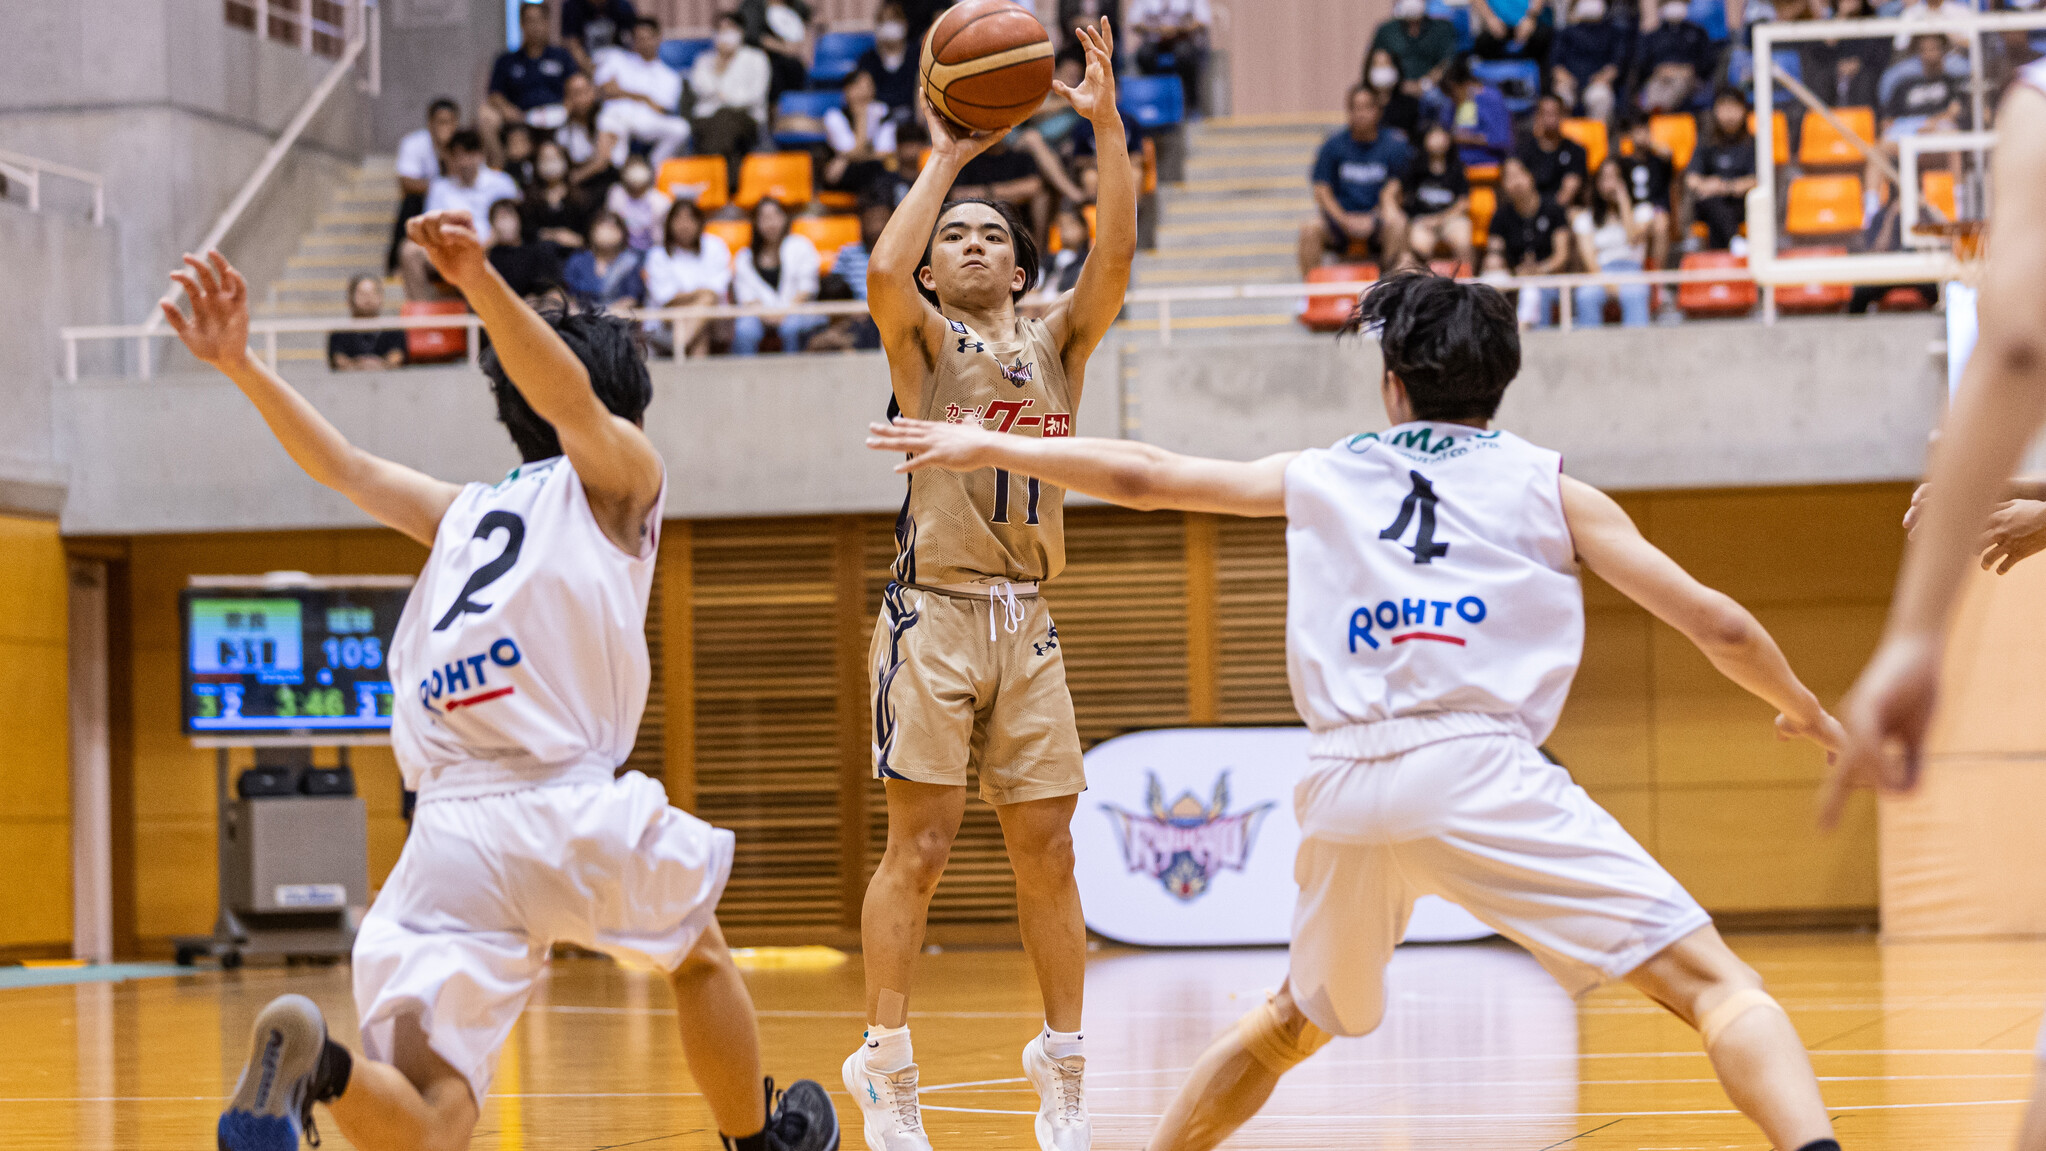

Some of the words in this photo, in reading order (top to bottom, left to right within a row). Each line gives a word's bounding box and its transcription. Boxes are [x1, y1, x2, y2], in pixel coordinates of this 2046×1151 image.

[1378, 470, 1449, 564] 4
[433, 510, 525, 631] 2
[322, 637, 383, 670] 105
[1349, 596, 1486, 653] ROHTO
[418, 638, 521, 716] ROHTO
